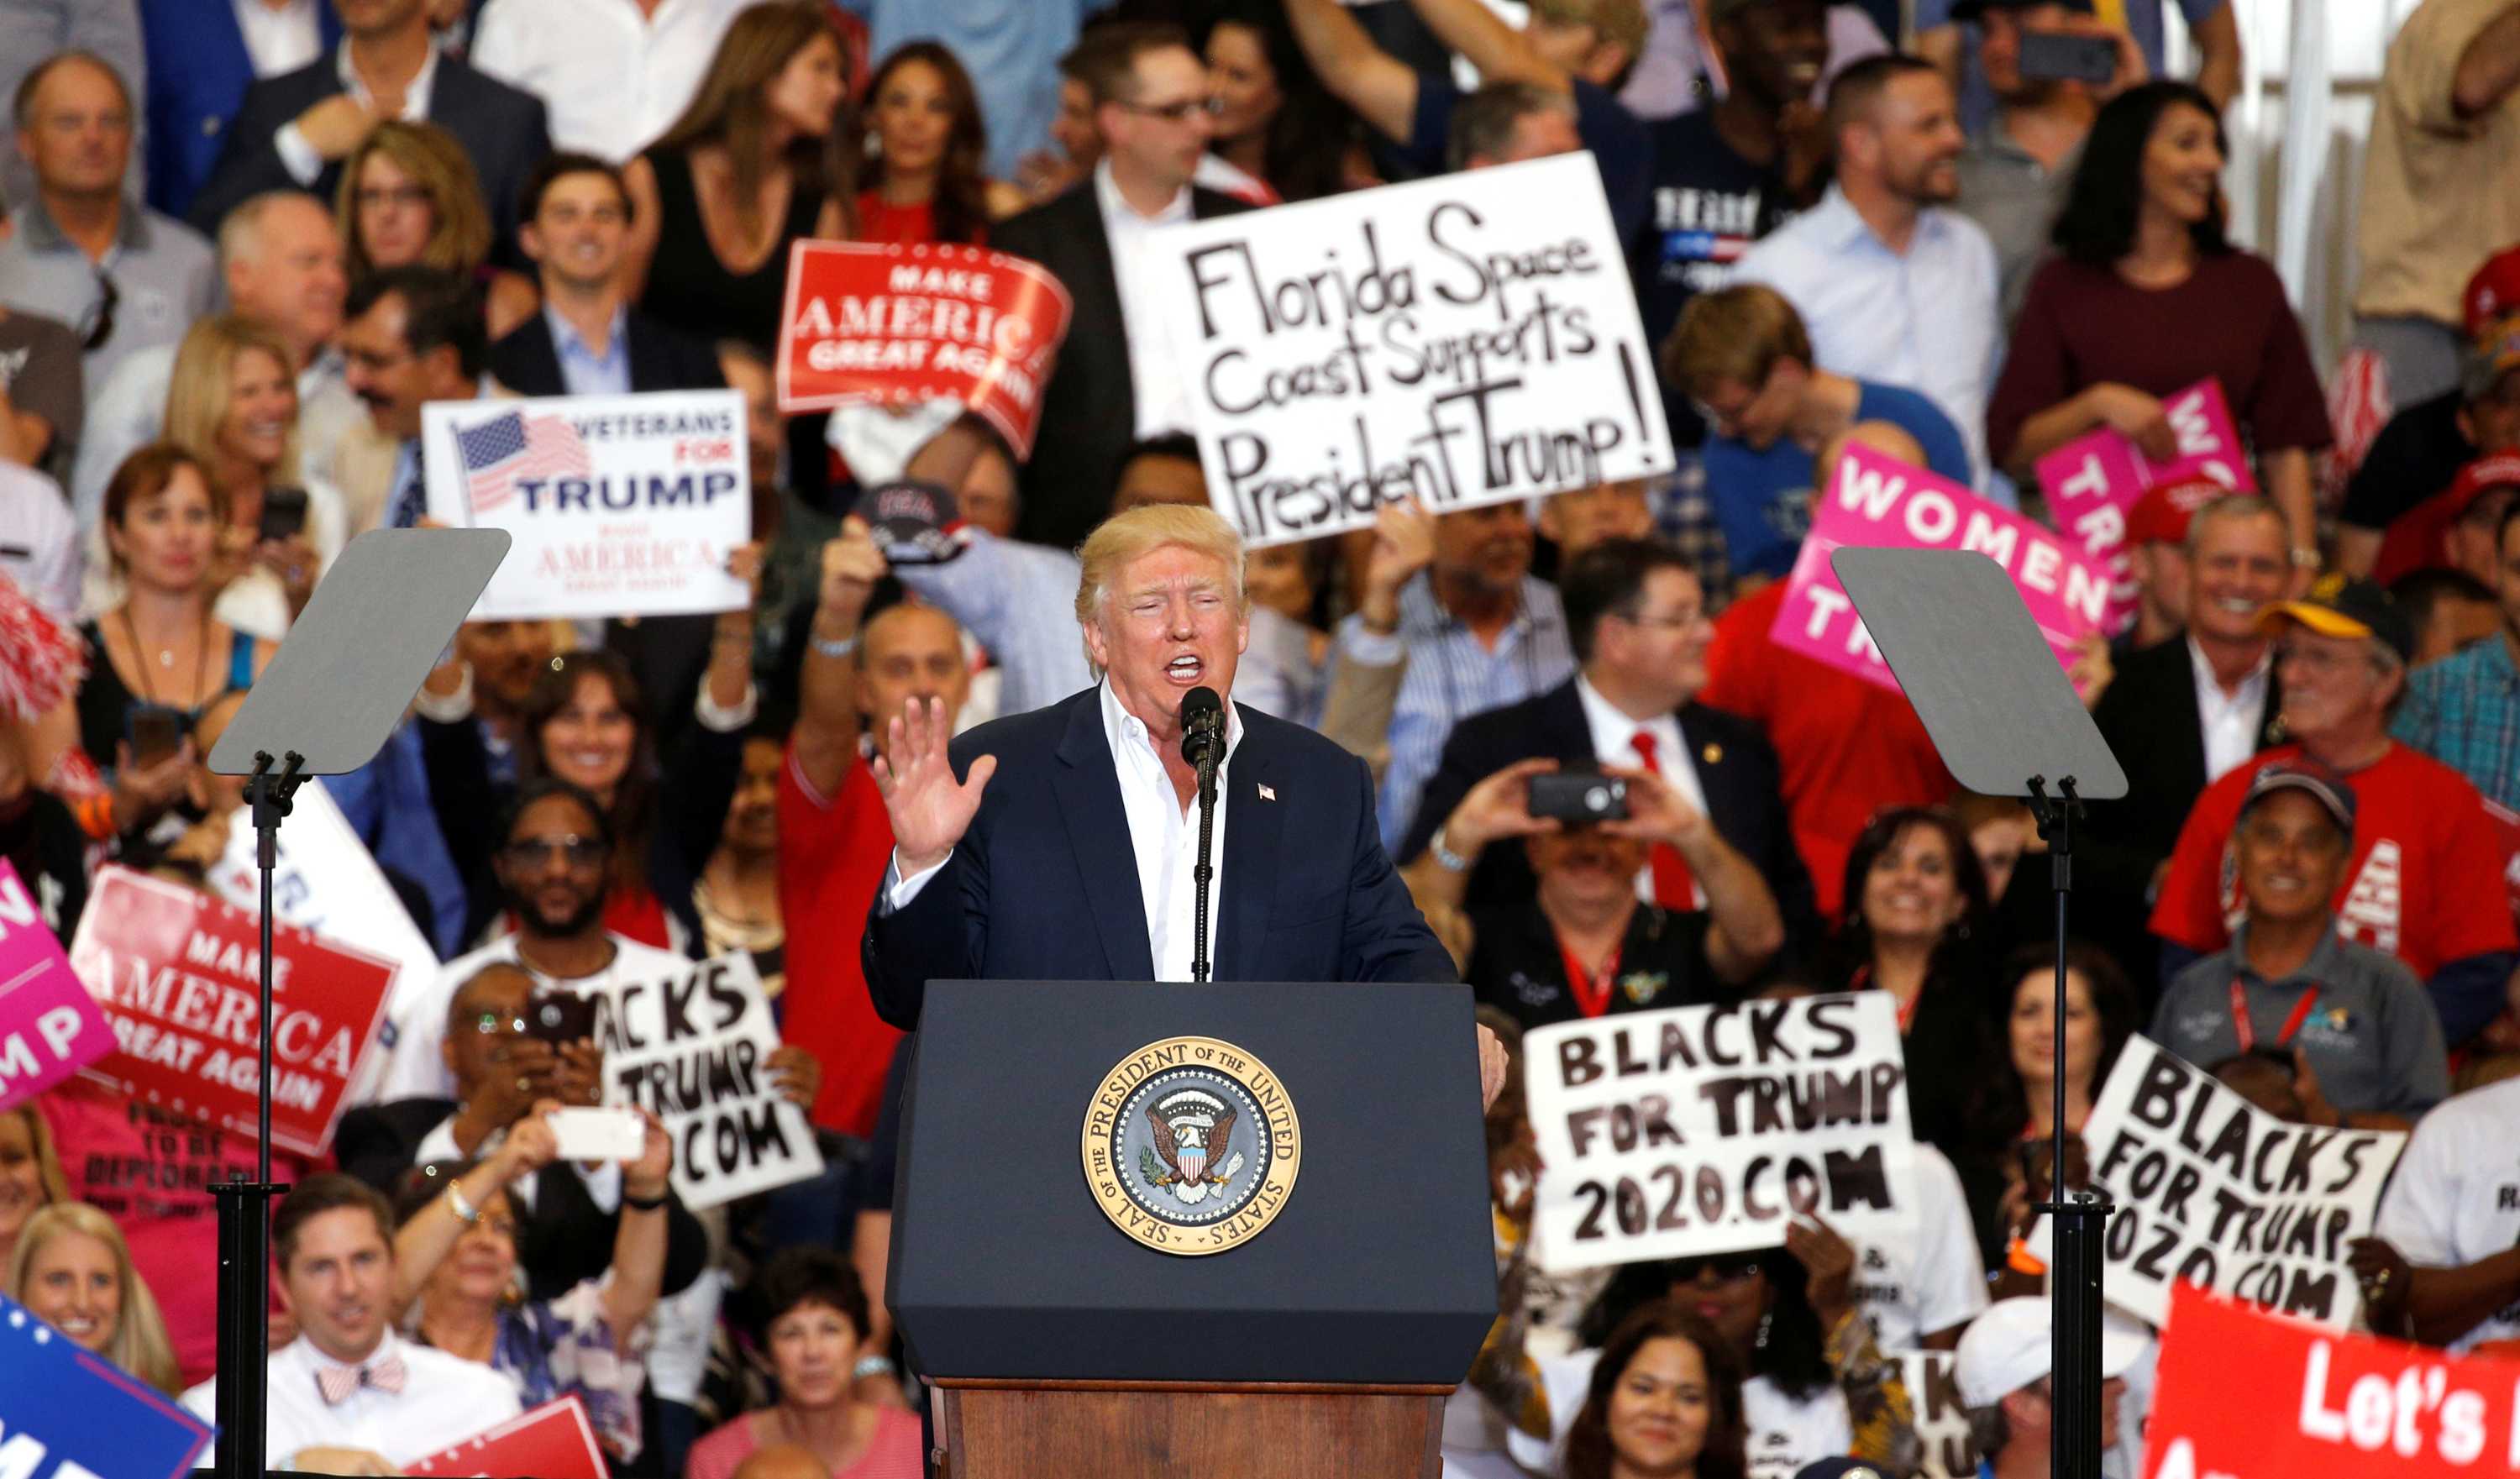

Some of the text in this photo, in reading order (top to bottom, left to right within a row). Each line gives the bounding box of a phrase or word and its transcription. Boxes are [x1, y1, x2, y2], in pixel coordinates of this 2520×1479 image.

[890, 264, 994, 302] MAKE
[1185, 201, 1599, 340] Florida Space
[807, 338, 929, 371] GREAT
[1205, 289, 1599, 414] Coast Supports
[575, 408, 733, 438] VETERANS
[675, 440, 733, 464] FOR
[1217, 339, 1654, 542] President Trump!
[517, 471, 738, 514] TRUMP
[1837, 454, 2111, 625] WOMEN
[102, 1010, 204, 1073] REAT
[618, 1040, 757, 1117] TRUMP
[1557, 999, 1856, 1087] BLACKS
[1090, 1044, 1294, 1245] SEAL OF THE PRESIDENT OF THE UNITED STATES
[1566, 1062, 1904, 1158] FOR TRUMP
[2130, 1052, 2377, 1194] BLACKS
[1572, 1144, 1894, 1241] 2020.COM
[2101, 1128, 2353, 1262] FOR TRUMP
[2299, 1339, 2488, 1466] Let's
